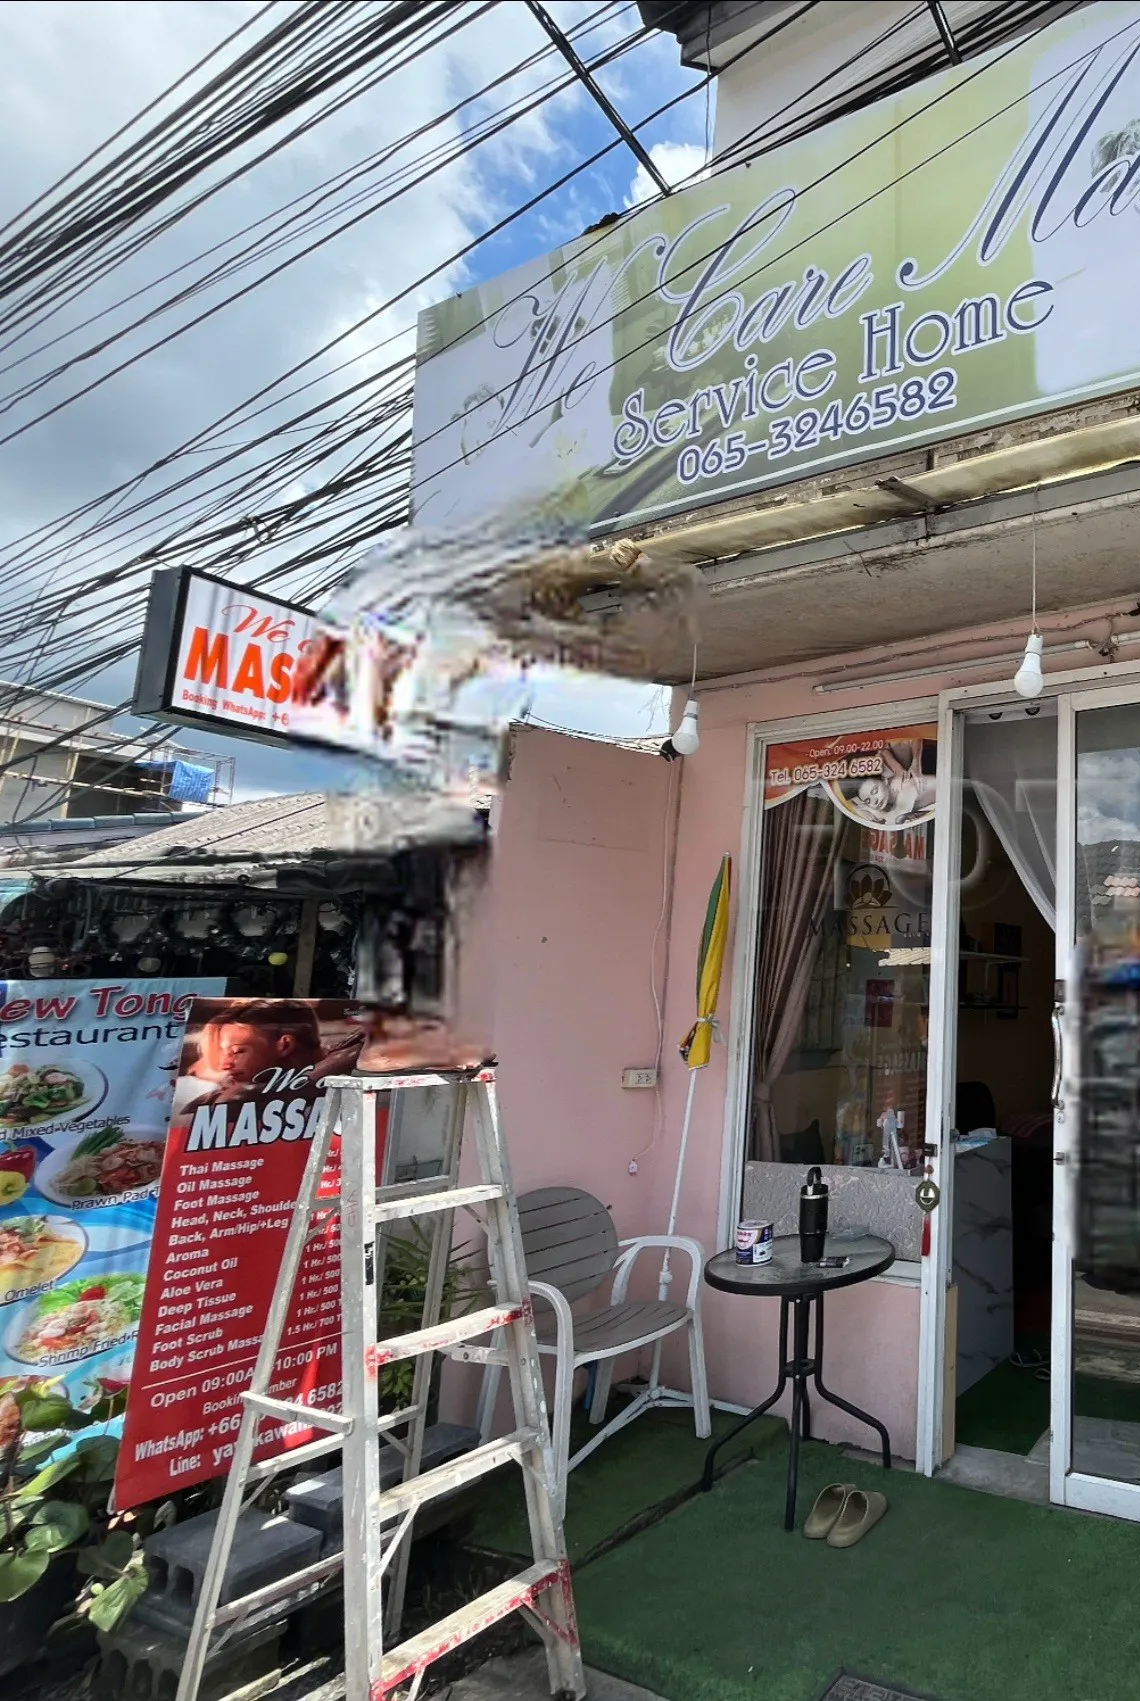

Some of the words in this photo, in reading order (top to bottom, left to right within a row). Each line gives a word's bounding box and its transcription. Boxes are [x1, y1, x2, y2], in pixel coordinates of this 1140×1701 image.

[657, 188, 872, 370] Care
[613, 350, 836, 459] Service
[862, 279, 1054, 381] Home
[679, 369, 957, 482] 065-3246582
[222, 604, 296, 643] We
[183, 626, 297, 704] MAS
[183, 689, 217, 710] Booking
[793, 762, 846, 781] 065-324
[850, 757, 882, 775] 6582
[810, 912, 930, 937] MASSAGE
[0, 995, 76, 1022] ew
[90, 985, 198, 1022] Tong
[252, 1064, 314, 1094] We
[186, 1096, 327, 1152] MASSA
[180, 1162, 209, 1177] Thai
[211, 1158, 264, 1173] Massage
[176, 1181, 196, 1194] Oil
[199, 1175, 252, 1191] Massage
[72, 1195, 117, 1210] Prawn
[174, 1198, 204, 1211] Foot
[207, 1190, 260, 1207] Massage
[171, 1213, 209, 1228] Head,
[213, 1208, 247, 1222] Neck,
[250, 1199, 298, 1216] Shoulde
[168, 1231, 206, 1246] Back,
[165, 1248, 209, 1264] Aroma
[163, 1262, 218, 1281] Coconut
[221, 1257, 238, 1270] Oil
[5, 1281, 55, 1302] Omelet
[160, 1285, 191, 1300] Aloe
[195, 1278, 223, 1293] Vera
[323, 1284, 339, 1295] 500
[158, 1302, 192, 1318] Deep
[197, 1292, 236, 1309] Tissue
[320, 1299, 336, 1312] 500
[155, 1316, 196, 1336] Facial
[200, 1304, 253, 1326] Massage
[319, 1315, 335, 1327] 700
[152, 1338, 183, 1354] Foot
[186, 1327, 223, 1346] Scrub
[38, 1345, 89, 1368] Shrimp
[149, 1355, 184, 1373] Body
[187, 1344, 225, 1362] Scrub
[227, 1334, 265, 1351] Massa
[151, 1385, 197, 1408] Open
[202, 1365, 255, 1394] 09:00A
[318, 1342, 338, 1358] PM
[202, 1393, 245, 1416] Bookin
[135, 1428, 204, 1462] WhatsApp:
[168, 1455, 201, 1477] Line:
